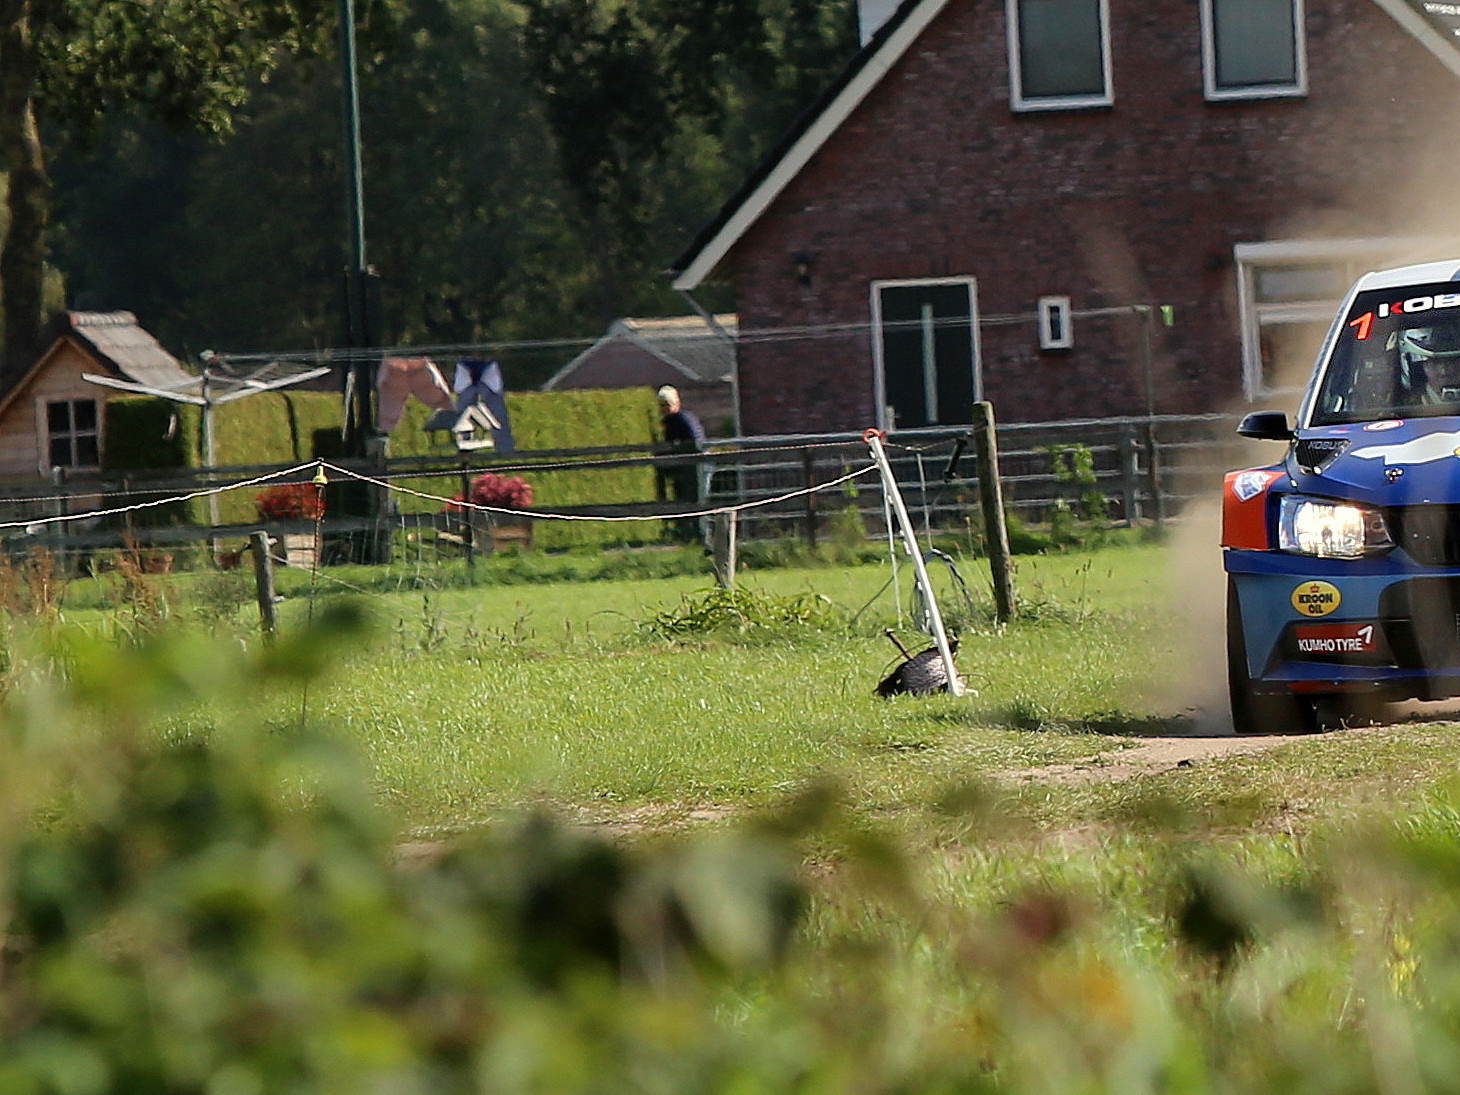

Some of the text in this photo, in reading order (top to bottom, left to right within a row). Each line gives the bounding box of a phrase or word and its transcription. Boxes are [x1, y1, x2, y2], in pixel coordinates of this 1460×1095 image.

[1350, 311, 1374, 340] 1
[1298, 593, 1333, 604] KROON
[1308, 604, 1323, 614] OIL
[1298, 638, 1363, 652] KUMHO TYRE
